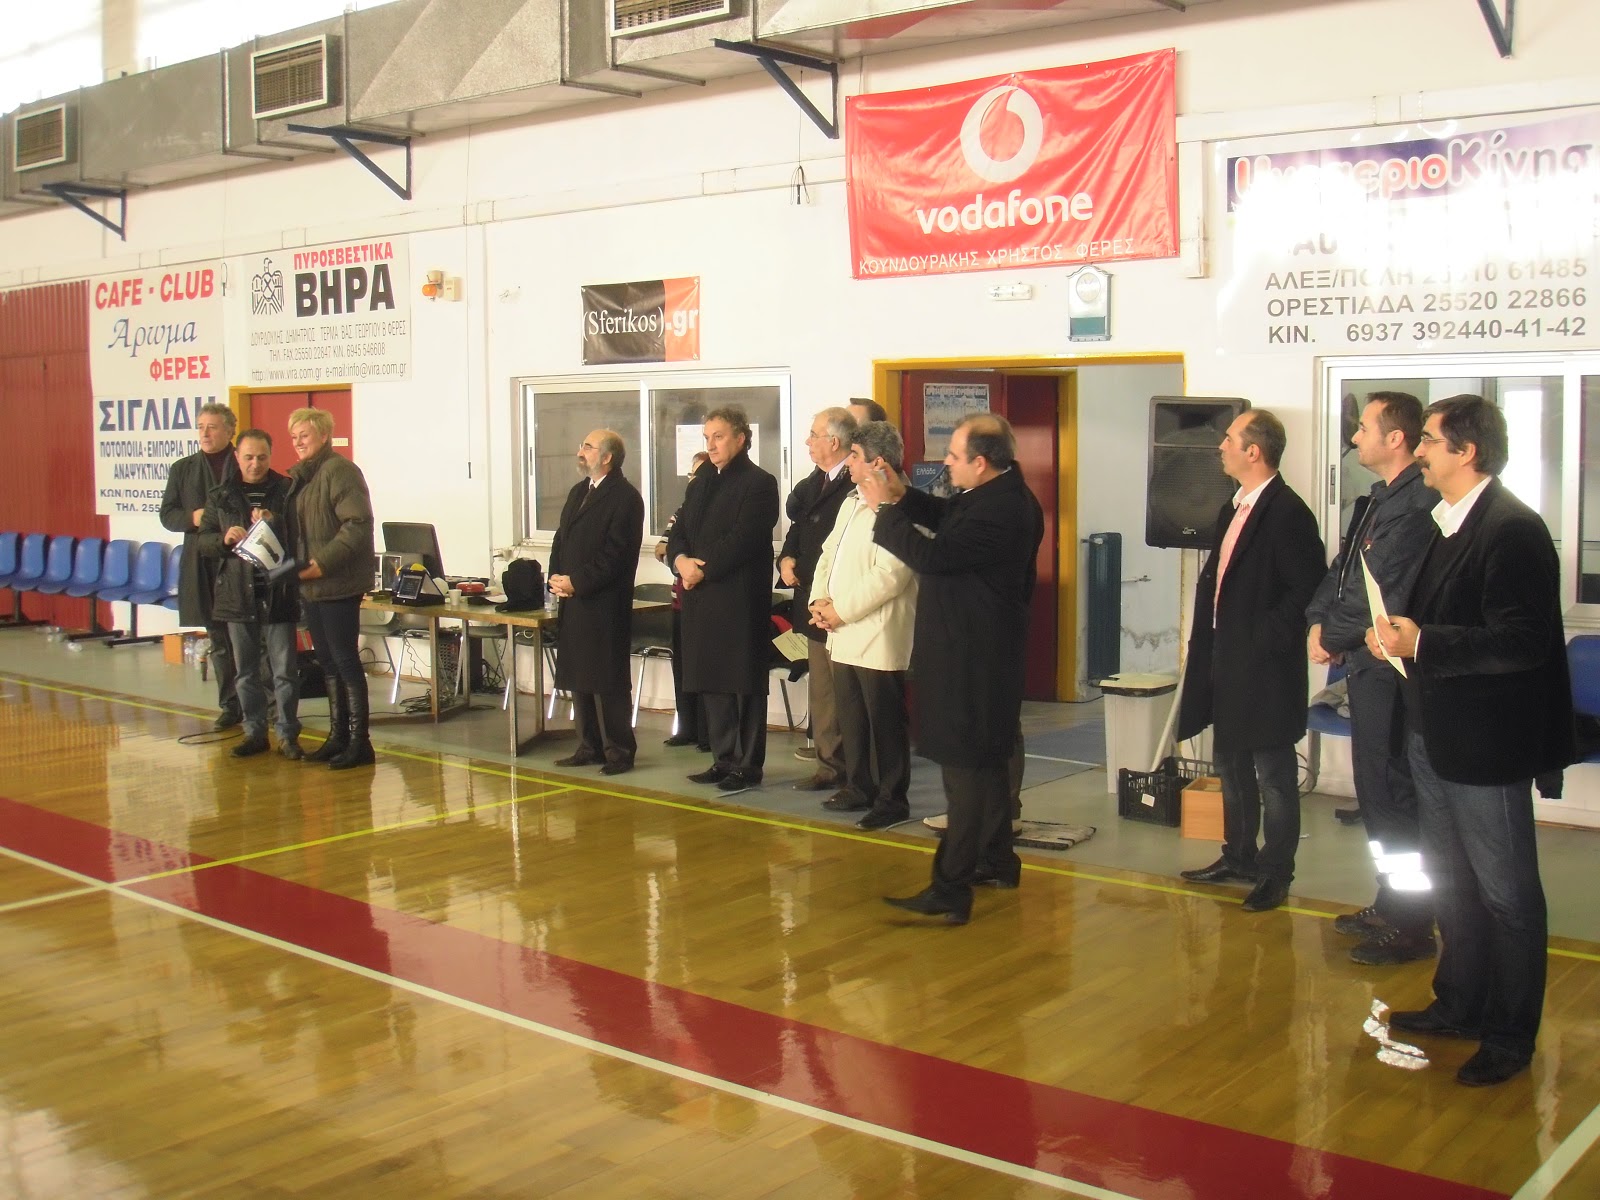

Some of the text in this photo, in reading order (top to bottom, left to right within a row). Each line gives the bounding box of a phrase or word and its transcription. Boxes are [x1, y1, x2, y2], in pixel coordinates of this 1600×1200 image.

[917, 189, 1093, 234] vodafone
[293, 241, 394, 270] ΠΥΡΟΣΒΕΣΤΙΚΑ
[859, 238, 1134, 275] ΚΟΥΝΔΟΥΡΑΚΗΣ ΧΡΗΣΤΟΣ ΦΕΡΕΣ
[1507, 258, 1587, 280] 61485
[95, 278, 143, 310] CAFE
[160, 269, 214, 302] CLUB
[295, 263, 395, 317] ΒΗΡΑ
[1267, 287, 1587, 317] ΟΡΕΣΤΙΑΔΑ 25520 22866
[108, 318, 198, 358] Αρωμα
[388, 320, 407, 336] ΦΕΡΕΣ
[1268, 316, 1586, 344] ΚΙΝ. 6937 392440-41-42
[314, 345, 332, 360] 22847
[347, 343, 362, 357] 6945
[150, 355, 211, 381] ΦΕΡΕΣ
[115, 503, 139, 512] ΤΗΛ.
